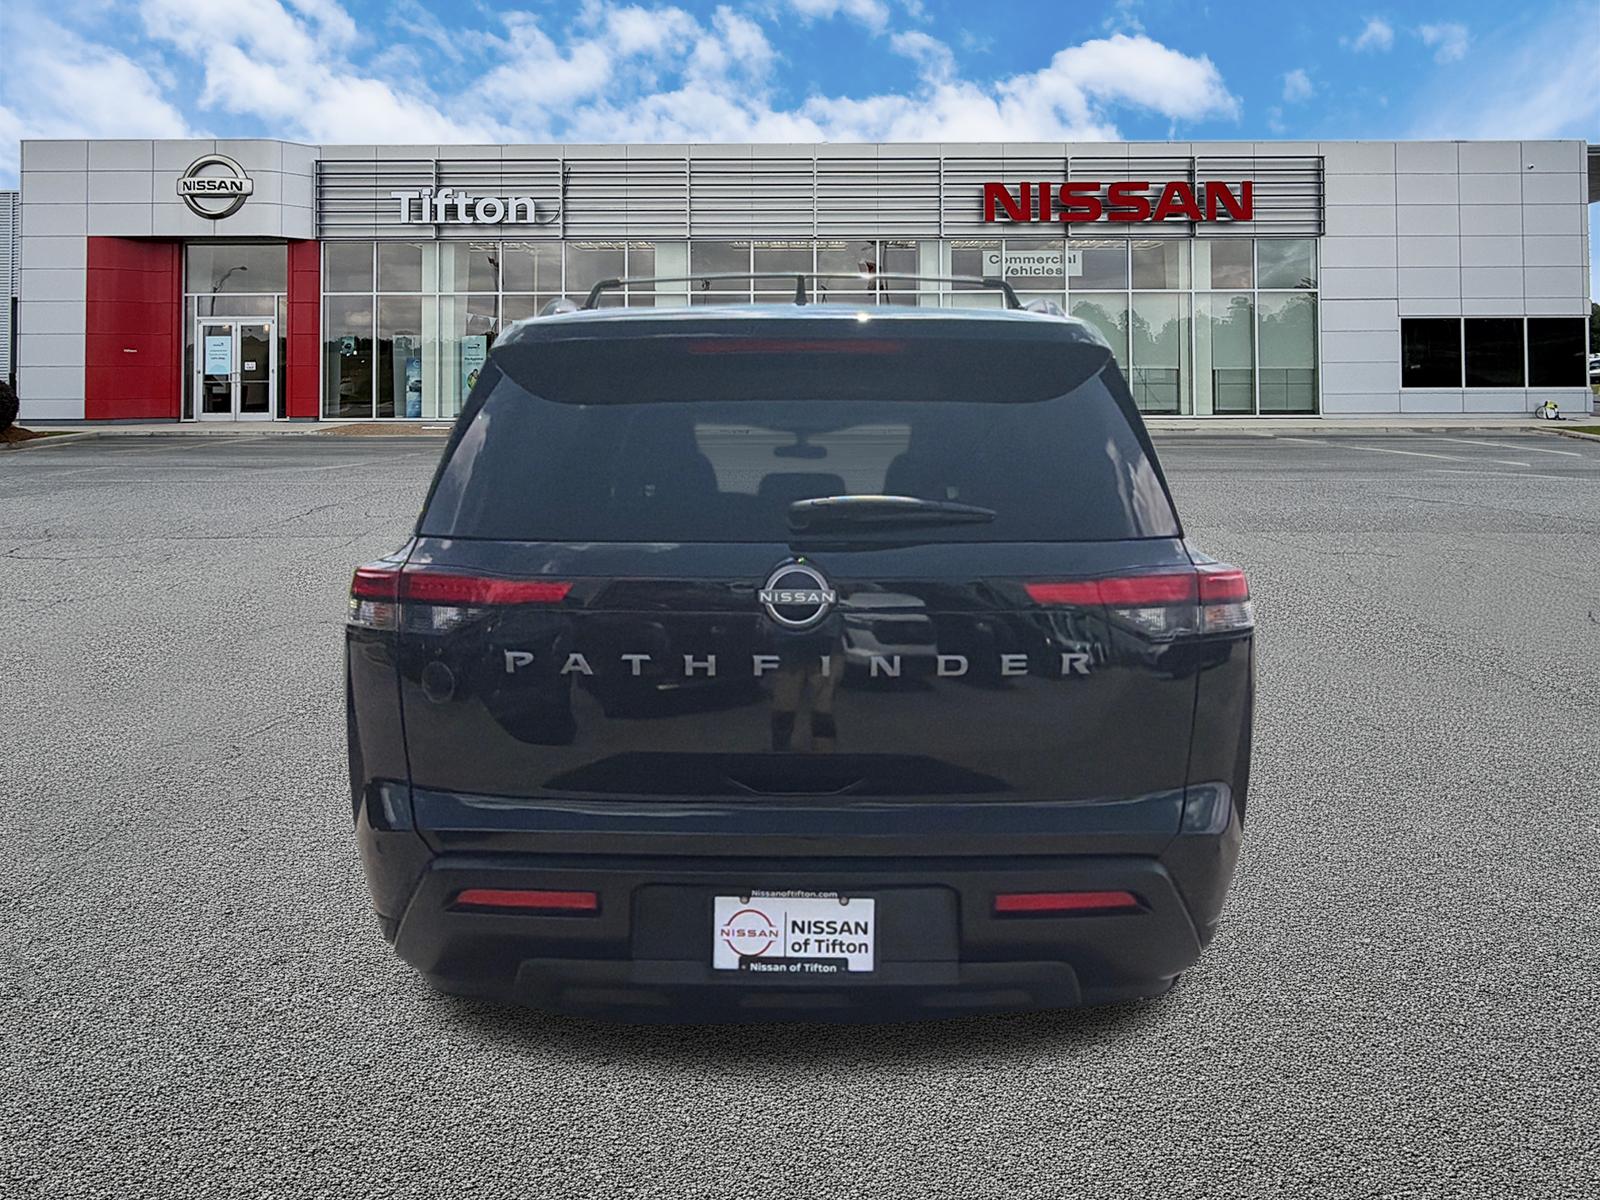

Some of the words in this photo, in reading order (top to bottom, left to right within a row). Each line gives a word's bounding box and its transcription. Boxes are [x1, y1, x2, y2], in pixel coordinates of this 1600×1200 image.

[182, 180, 243, 191] NISSAN
[391, 188, 536, 224] Tifton
[983, 181, 1253, 222] NISSAN
[759, 592, 835, 603] NISSAN
[503, 649, 1093, 677] PATHFINDER
[751, 889, 838, 898] Nissanoftifton.com
[720, 929, 779, 938] NISSAN
[791, 920, 869, 935] NISSAN
[791, 939, 811, 953] of
[814, 939, 869, 954] Tifton
[749, 962, 785, 973] Nissan
[789, 962, 802, 973] of
[804, 963, 837, 974] Tifton
